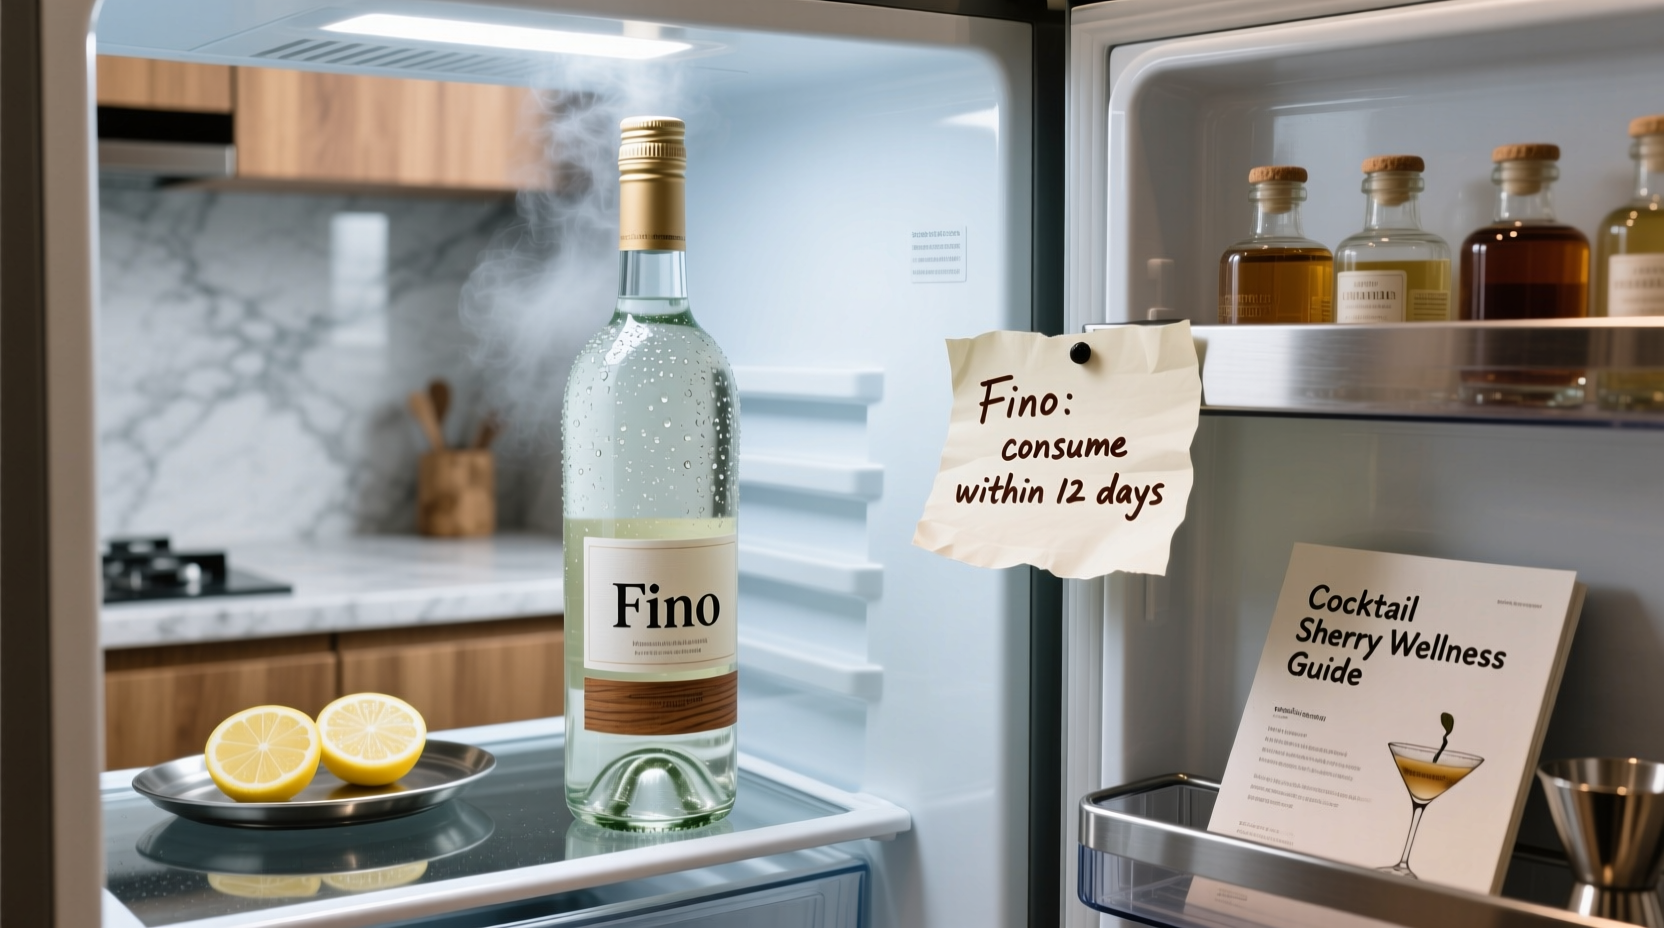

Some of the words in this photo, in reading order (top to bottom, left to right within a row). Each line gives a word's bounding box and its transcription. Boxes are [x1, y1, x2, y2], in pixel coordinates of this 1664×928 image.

[979, 374, 1073, 424] Fino:
[1001, 436, 1128, 461] consume
[955, 472, 1044, 504] within
[1056, 477, 1086, 504] 12
[1096, 472, 1165, 521] days
[612, 582, 720, 629] Fino
[1308, 584, 1420, 622] Cocktail
[1296, 616, 1383, 661] Sherry
[1391, 629, 1507, 669] Wellness
[1287, 651, 1363, 686] Guide
